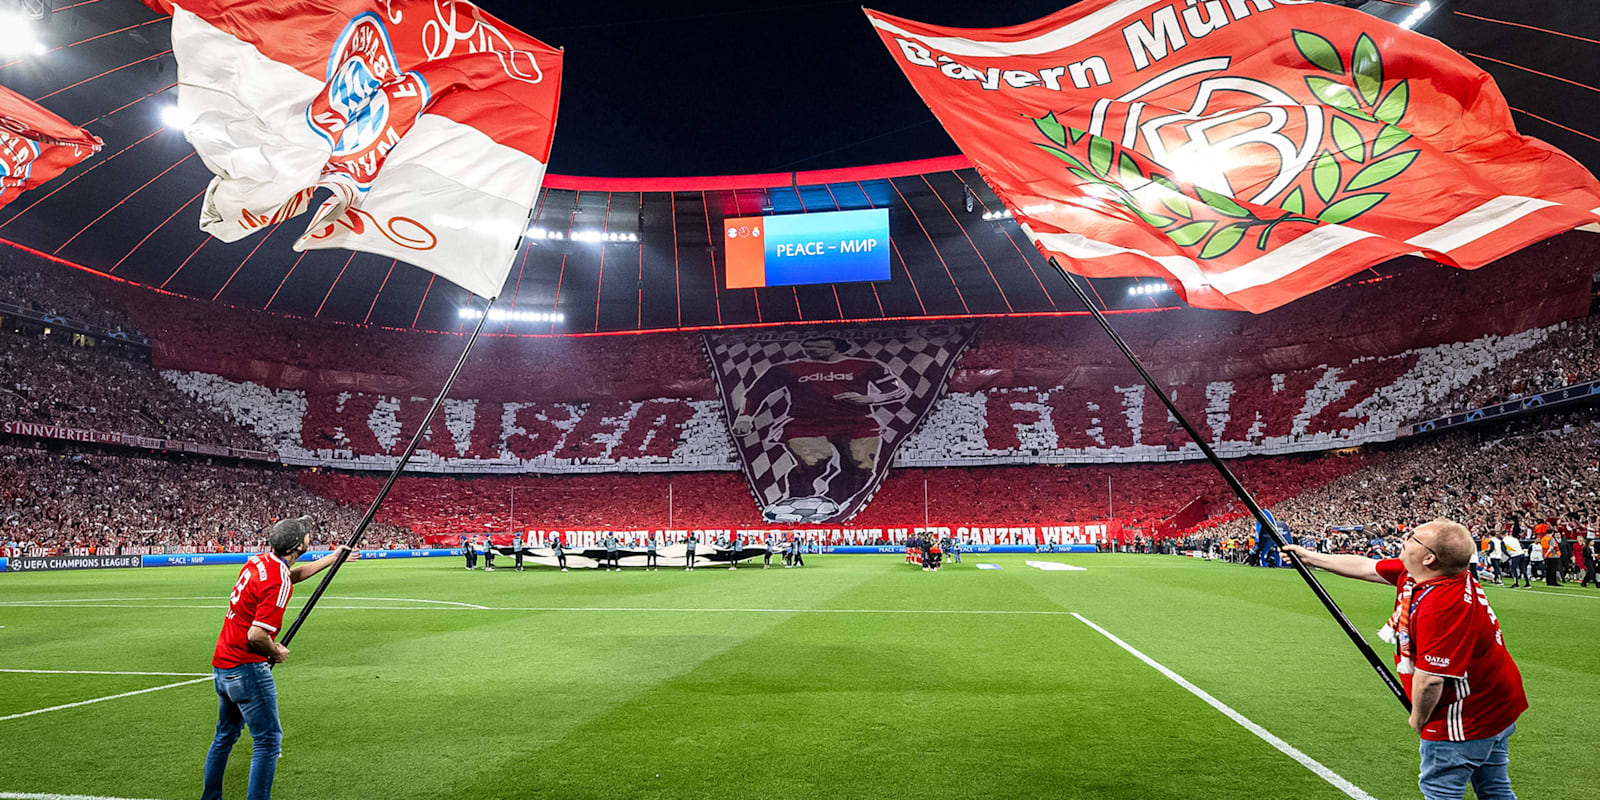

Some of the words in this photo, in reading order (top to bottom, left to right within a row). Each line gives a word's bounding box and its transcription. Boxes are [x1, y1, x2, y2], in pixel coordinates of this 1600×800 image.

[893, 37, 1113, 91] Bayern
[777, 242, 824, 257] PEACE
[840, 238, 877, 253] МИР
[798, 371, 854, 383] adidas
[957, 526, 1035, 545] GANZEN
[1041, 524, 1106, 544] WELT!
[24, 559, 48, 569] UEFA
[49, 558, 98, 568] CHAMPIONS
[101, 557, 130, 567] LEAGUE
[1424, 654, 1450, 664] QATAR
